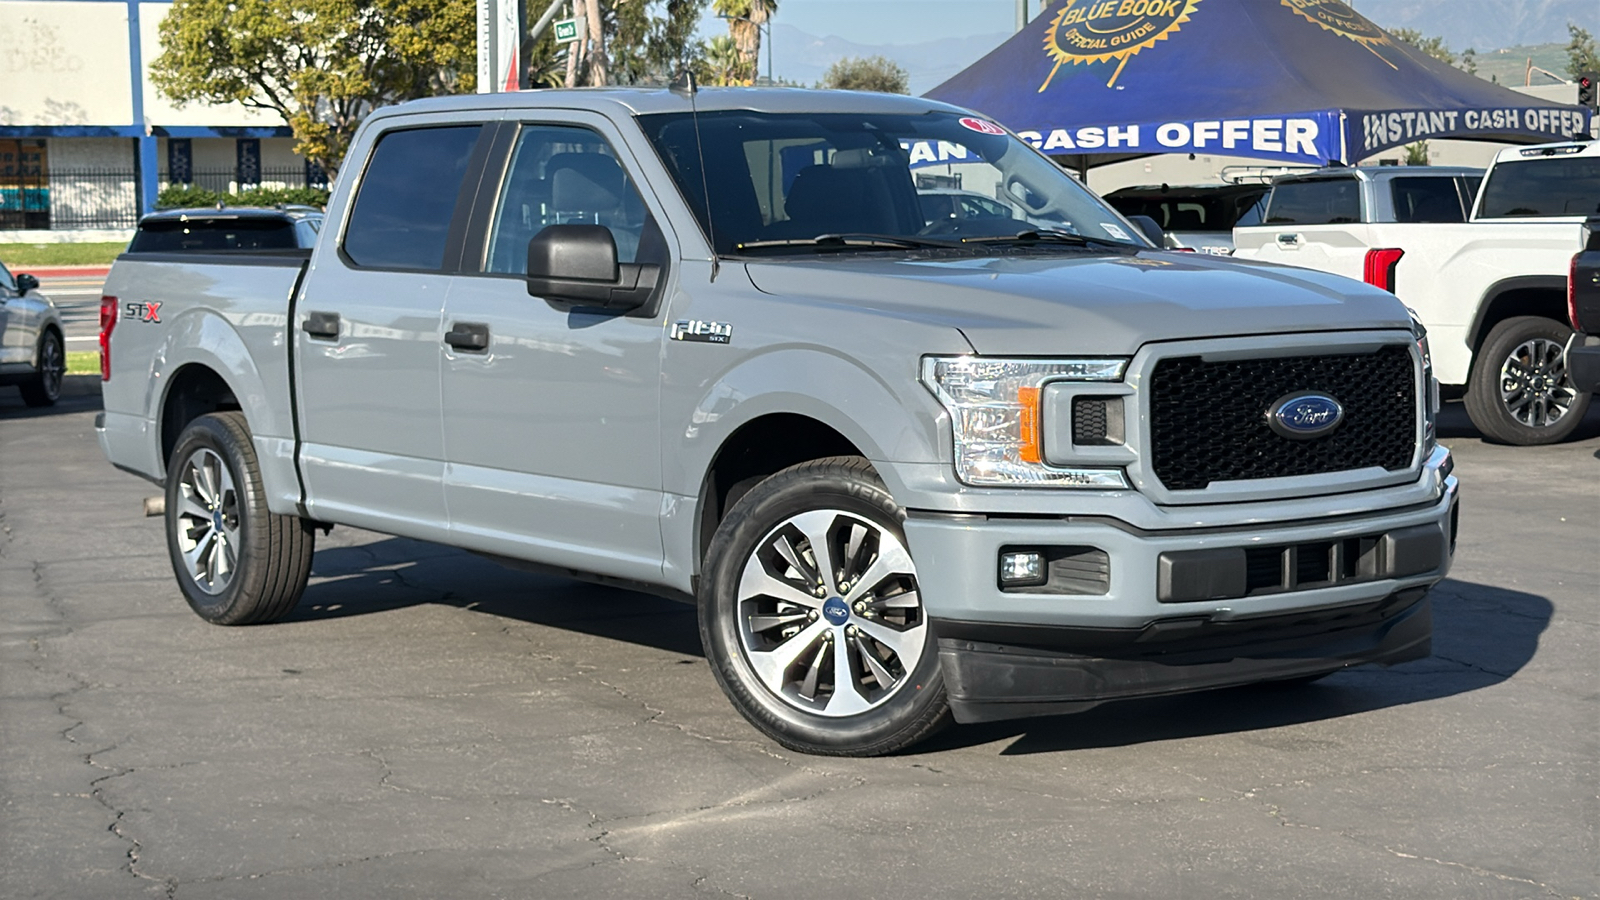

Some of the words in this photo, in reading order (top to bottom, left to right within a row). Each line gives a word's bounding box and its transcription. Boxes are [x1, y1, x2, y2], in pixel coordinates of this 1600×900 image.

[1062, 1, 1112, 26] BLUE
[1117, 0, 1181, 17] BOOK
[1065, 28, 1108, 49] OFFICIAL
[1110, 22, 1156, 46] GUIDE
[1017, 125, 1139, 149] CASH
[1156, 119, 1319, 156] OFFER
[1363, 110, 1458, 150] INSTANT
[1464, 109, 1519, 131] CASH
[1524, 109, 1585, 137] OFFER
[1202, 246, 1229, 256] TRD
[124, 301, 163, 323] STX
[1294, 404, 1329, 424] Ford
